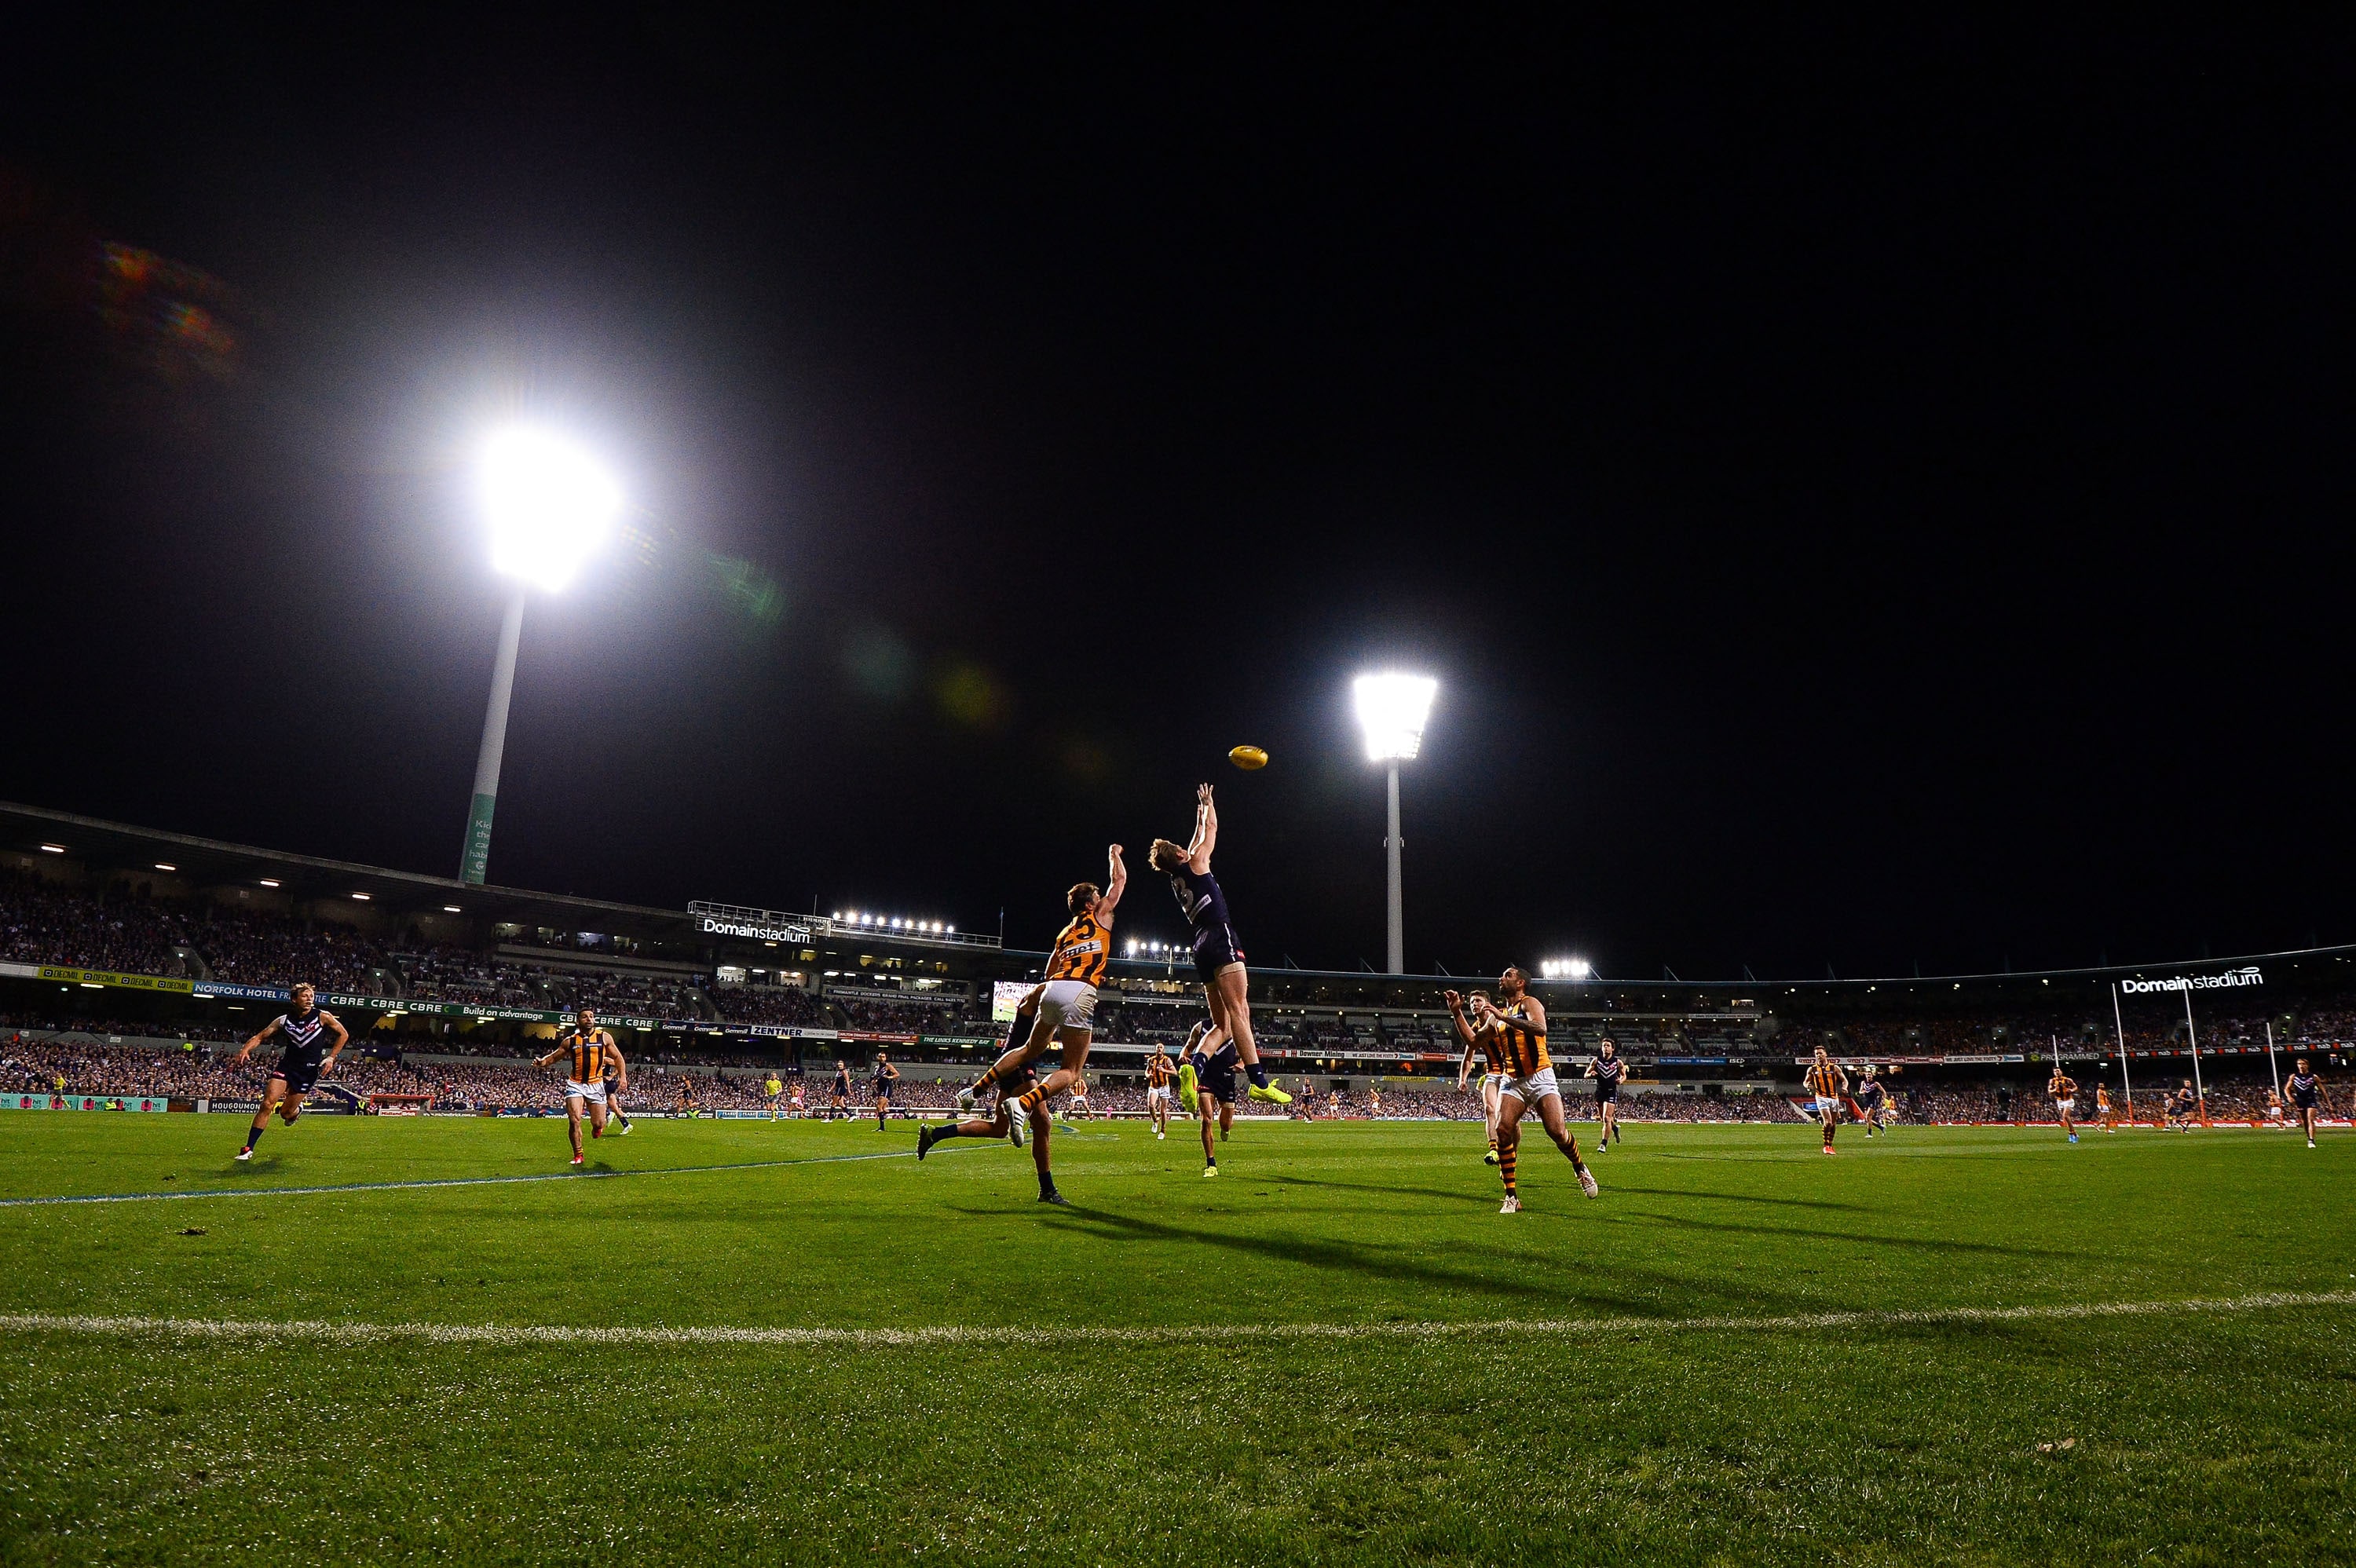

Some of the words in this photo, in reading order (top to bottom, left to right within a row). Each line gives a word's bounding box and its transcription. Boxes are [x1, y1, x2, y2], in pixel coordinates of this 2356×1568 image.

[53, 970, 78, 980] DECMIL
[93, 973, 116, 984] DECMIL
[130, 976, 153, 988] DECMIL
[166, 980, 188, 991] DECMIL
[195, 984, 243, 996] NORFOLK
[246, 989, 276, 999] HOTEL
[331, 996, 365, 1006] CBRE
[371, 999, 404, 1010] CBRE
[409, 1003, 442, 1013] CBRE
[463, 1007, 485, 1016] Build
[499, 1010, 543, 1021] advantage
[594, 1016, 621, 1025] CBRE
[626, 1018, 653, 1028] CBRE
[754, 1026, 803, 1036] ZENTNER
